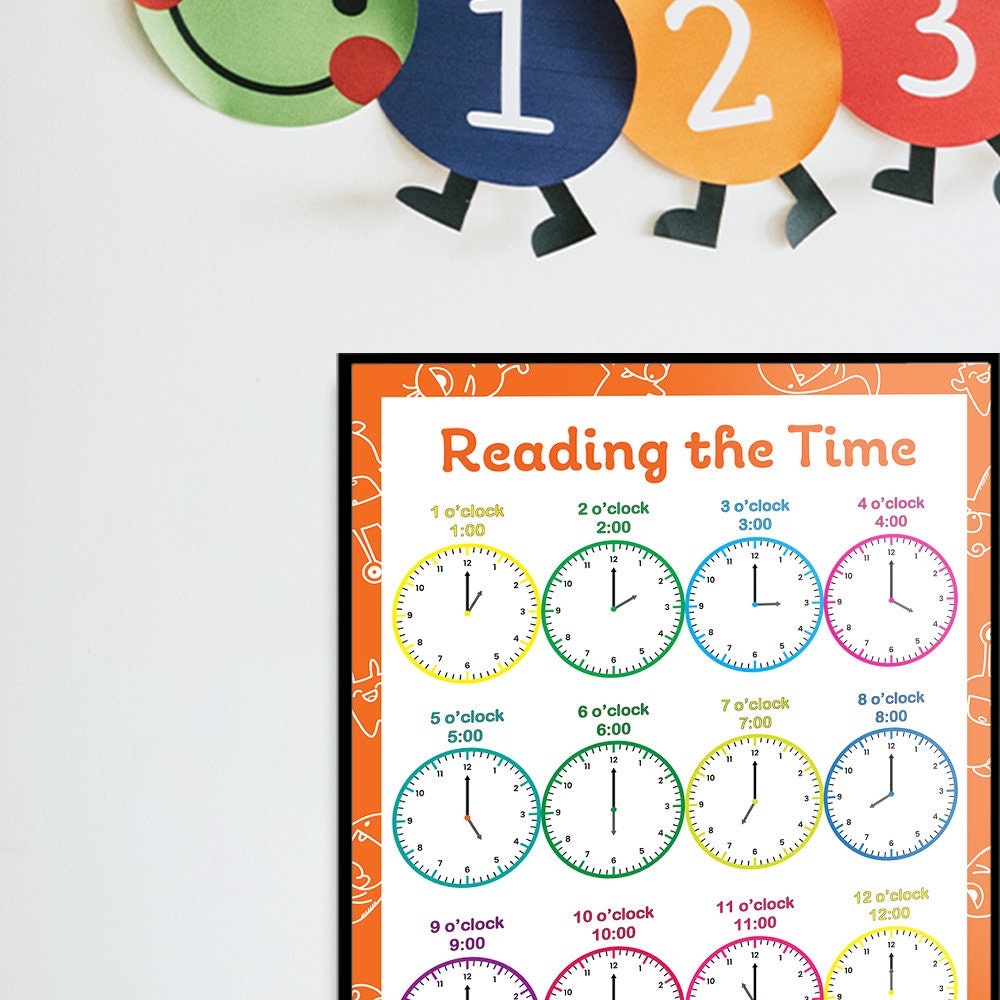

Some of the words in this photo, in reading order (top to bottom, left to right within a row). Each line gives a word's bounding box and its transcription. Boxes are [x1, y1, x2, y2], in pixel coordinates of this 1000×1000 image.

[897, 0, 976, 98] 3
[466, 0, 555, 135] 1
[664, 0, 774, 132] 2
[441, 426, 668, 484] Reading
[684, 424, 774, 469] the
[787, 424, 916, 468] Time
[578, 502, 588, 515] 2
[591, 501, 649, 515] o'clock
[721, 500, 730, 513] 3
[734, 499, 790, 512] o'clock
[857, 497, 867, 510] 4
[871, 496, 925, 509] o'clock
[431, 505, 438, 518] 1
[444, 504, 505, 518] o'clock
[596, 520, 631, 534] 2:00
[739, 518, 772, 531] 3:00
[875, 515, 907, 528] 4:00
[450, 523, 485, 537] 1:00
[721, 699, 731, 712] 7
[734, 697, 790, 711] o'clock
[858, 693, 867, 705] 8
[871, 691, 924, 705] o'clock
[430, 712, 441, 725] 5
[445, 709, 504, 724] o'clock
[578, 705, 588, 718] 6
[592, 703, 649, 717] o'clock
[875, 710, 907, 723] 8:00
[596, 722, 631, 736] 6:00
[739, 716, 772, 730] 7:00
[448, 729, 483, 743] 5:00
[854, 891, 872, 904] 12
[875, 887, 929, 903] o'clock
[716, 900, 733, 914] 11
[739, 896, 795, 912] o'clock
[573, 910, 592, 923] 10
[597, 906, 654, 922] o'clock
[869, 906, 910, 921] 12:00
[430, 920, 440, 933] 9
[445, 916, 504, 932] o'clock
[734, 916, 776, 931] 11:00
[592, 926, 636, 941] 10:00
[449, 937, 485, 951] 9:00
